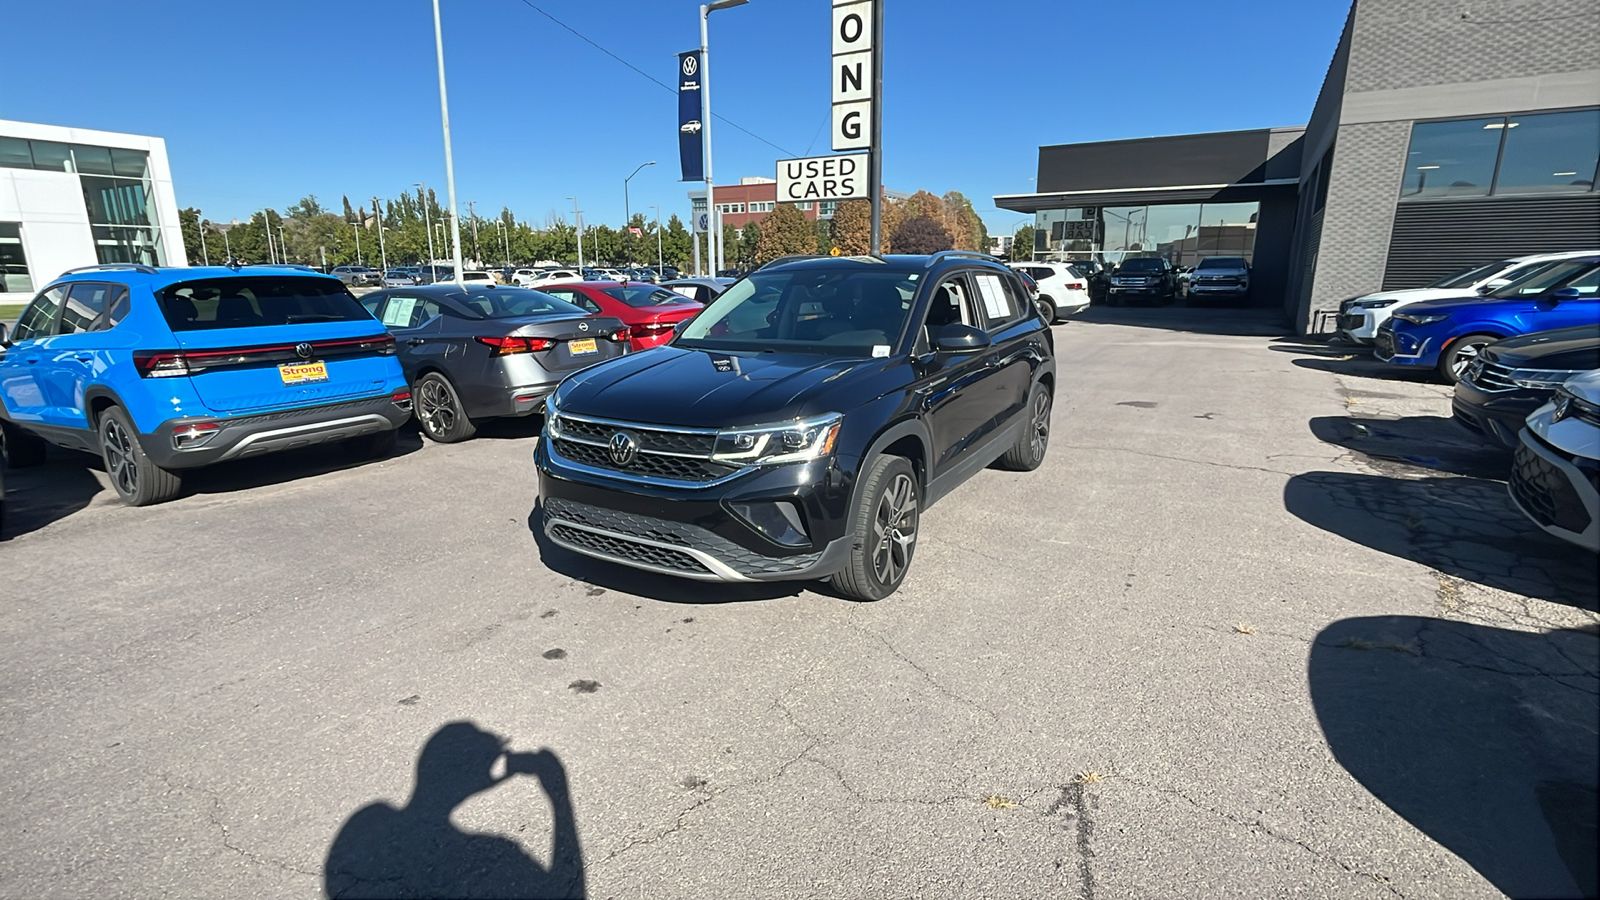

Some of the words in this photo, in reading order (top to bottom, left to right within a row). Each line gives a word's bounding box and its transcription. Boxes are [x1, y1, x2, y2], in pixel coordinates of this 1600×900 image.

[787, 158, 856, 180] USED
[788, 177, 855, 199] CARS
[282, 365, 323, 375] Strong
